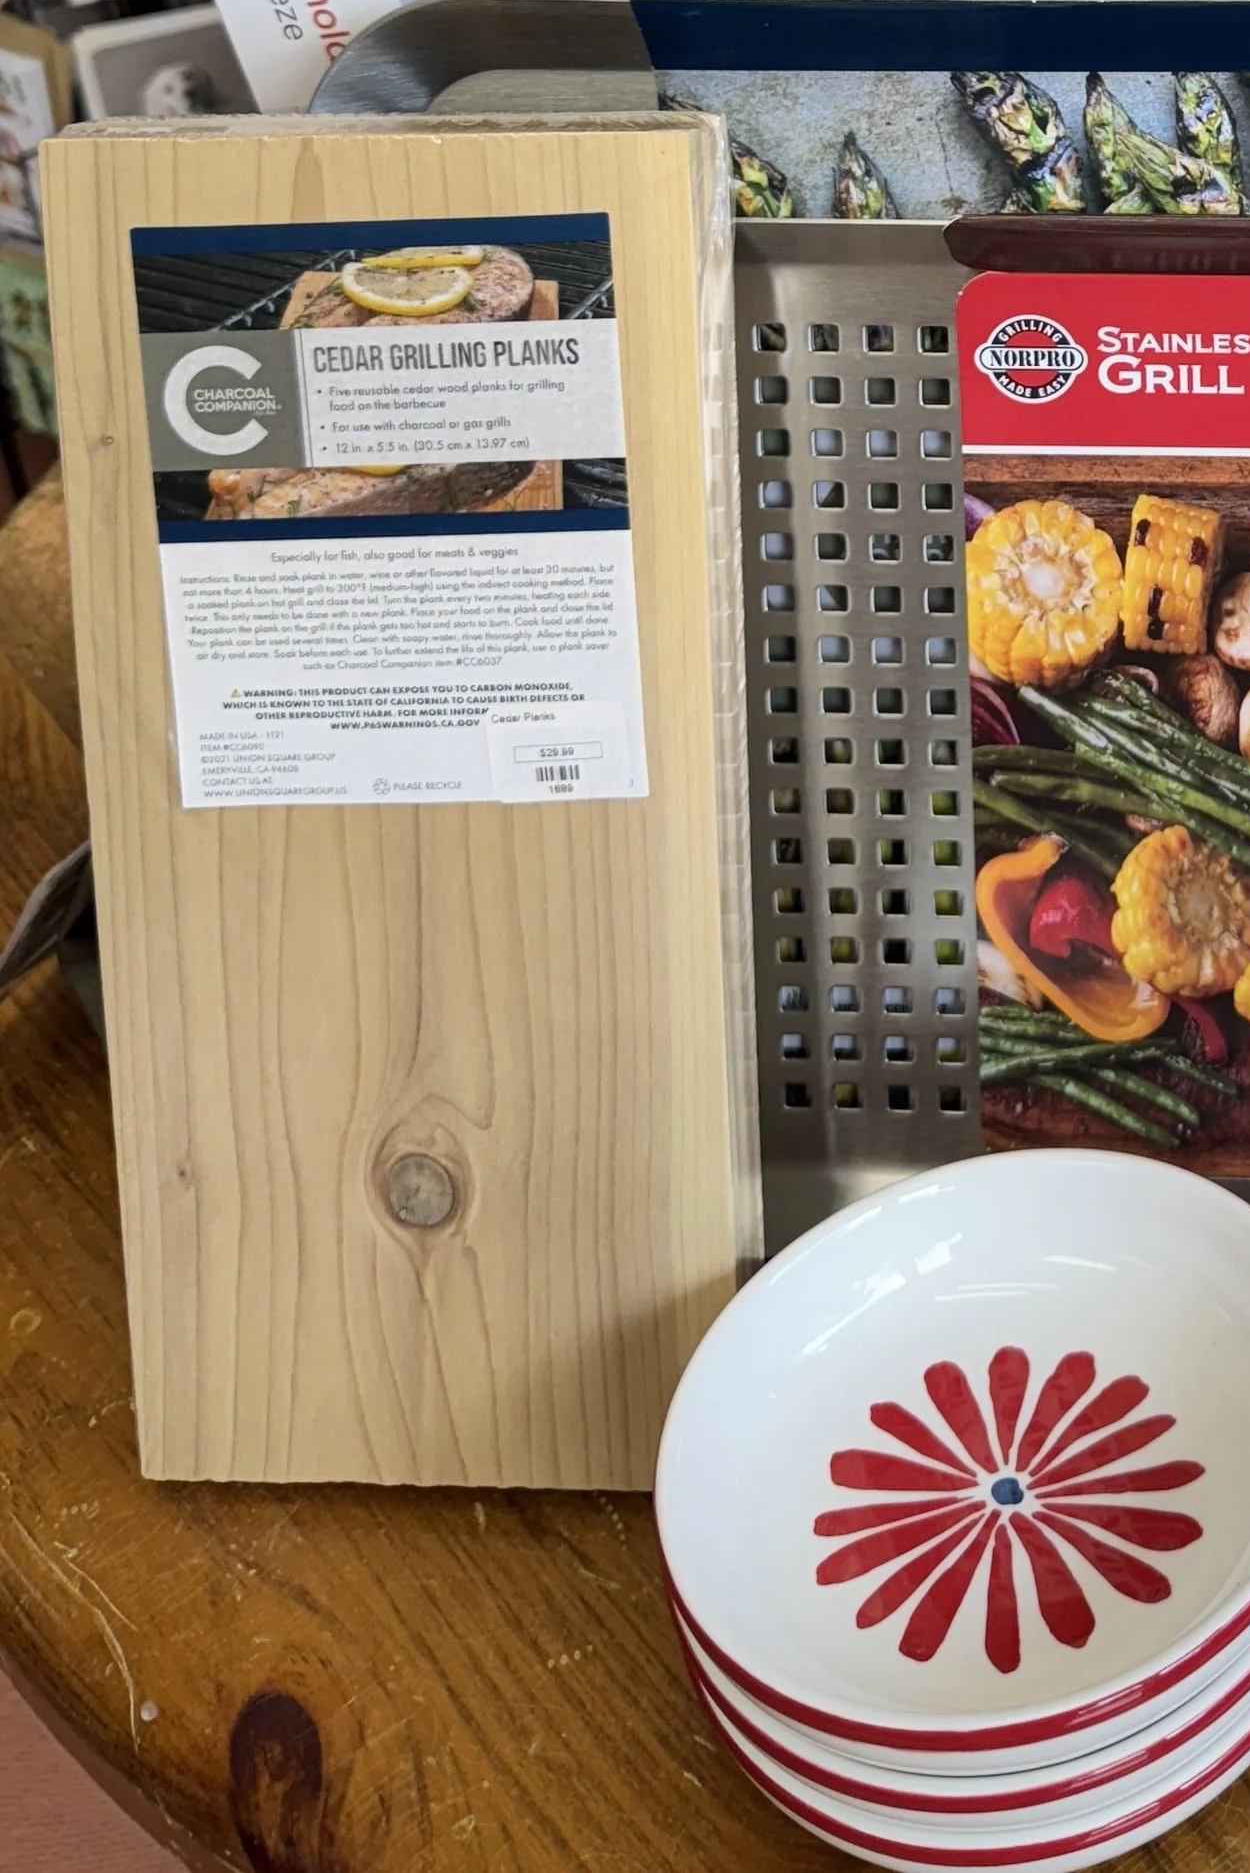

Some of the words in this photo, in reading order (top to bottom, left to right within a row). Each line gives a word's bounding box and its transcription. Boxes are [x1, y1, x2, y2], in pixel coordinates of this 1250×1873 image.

[998, 319, 1062, 343] GRILLING
[313, 345, 383, 372] CEDAR
[389, 341, 487, 370] GRILLING
[493, 338, 580, 366] PLANKS
[987, 349, 1077, 368] NORPRO
[194, 387, 275, 400] CHARCOAL
[329, 386, 351, 396] Five
[354, 384, 400, 395] reusable
[403, 384, 434, 394] cedar
[438, 381, 468, 393] wood
[472, 381, 506, 394] planks
[509, 380, 524, 390] for
[527, 379, 565, 392] grilling
[998, 375, 1032, 399] MADE
[1038, 374, 1067, 398] EASY
[329, 400, 355, 411] food
[358, 402, 371, 410] on
[374, 399, 391, 409] the
[394, 398, 446, 409] barbecue
[332, 422, 349, 432] For
[374, 420, 396, 431] with
[398, 418, 446, 431] charcoal
[449, 421, 460, 429] or
[463, 420, 483, 431] gas
[486, 416, 511, 430] grills
[272, 551, 322, 564] Especially
[324, 550, 338, 561] for
[364, 549, 385, 560] also
[388, 548, 415, 560] good
[418, 548, 432, 559] for
[435, 548, 465, 558] meats
[468, 547, 477, 557] &
[479, 547, 518, 559] veggies
[243, 689, 297, 697] WARNING:
[299, 688, 320, 696] THIS
[322, 688, 367, 696] PRODUCT
[369, 687, 390, 695] CAN
[392, 685, 430, 695] EXPOSE
[432, 685, 453, 694] YOU
[456, 685, 468, 693] TO
[470, 684, 512, 692] CARBON
[514, 682, 574, 692] MONOXIDE,
